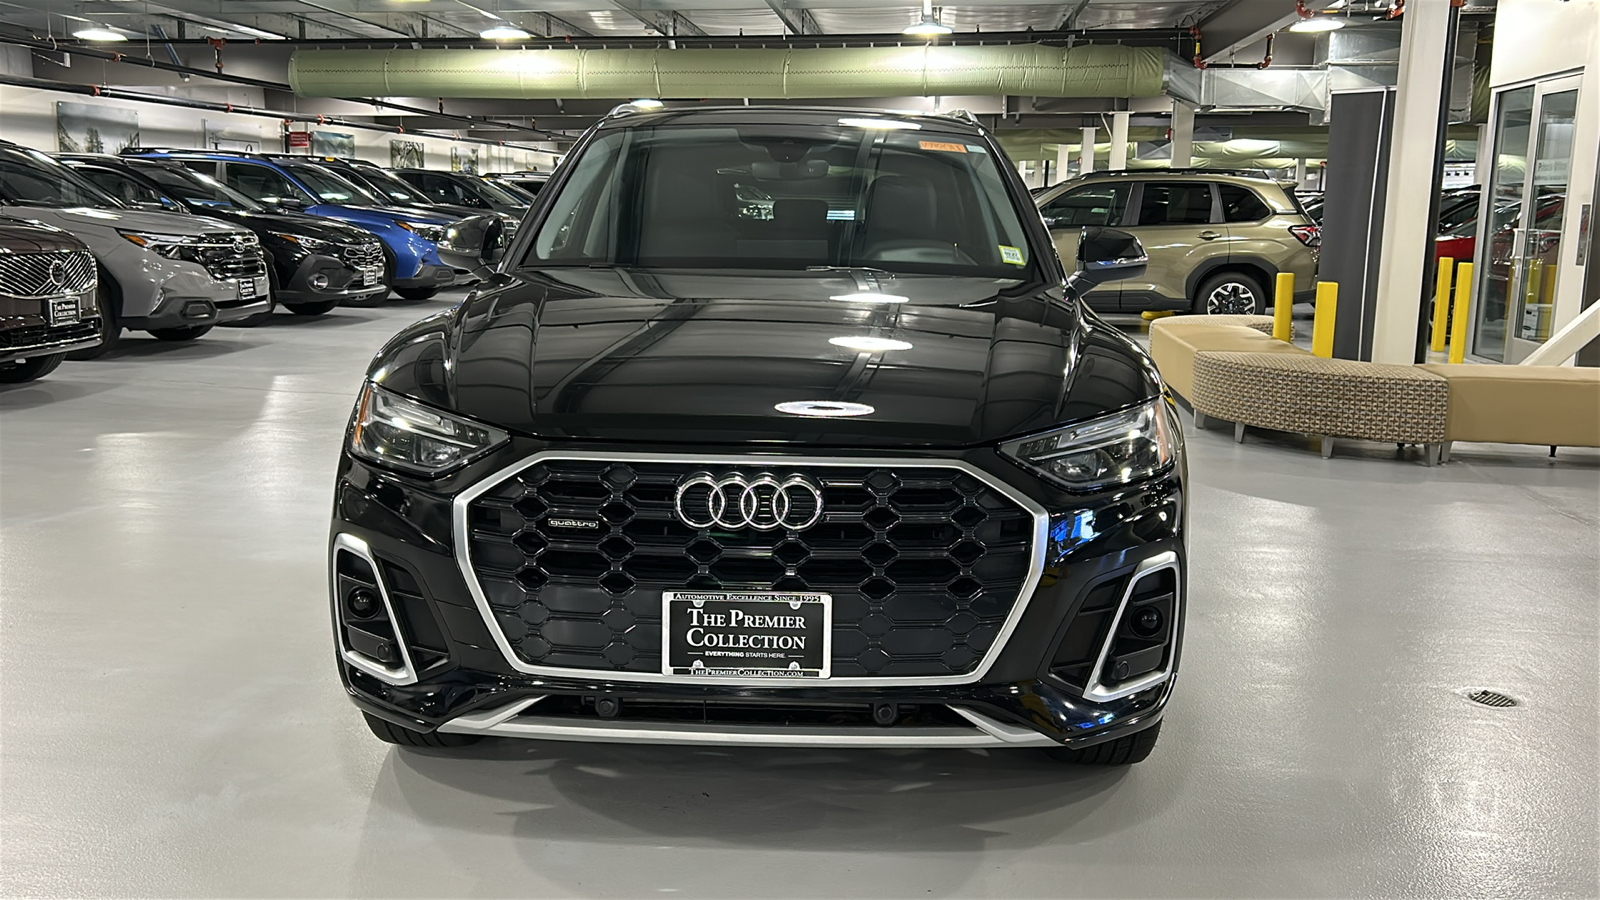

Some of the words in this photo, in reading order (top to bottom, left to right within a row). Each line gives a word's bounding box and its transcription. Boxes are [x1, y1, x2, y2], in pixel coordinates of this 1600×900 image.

[726, 593, 772, 601] EXCELLENCE
[774, 594, 796, 602] SINCE
[687, 608, 726, 627] THE
[729, 609, 806, 629] PREMIER
[686, 628, 806, 650] COLLECTION
